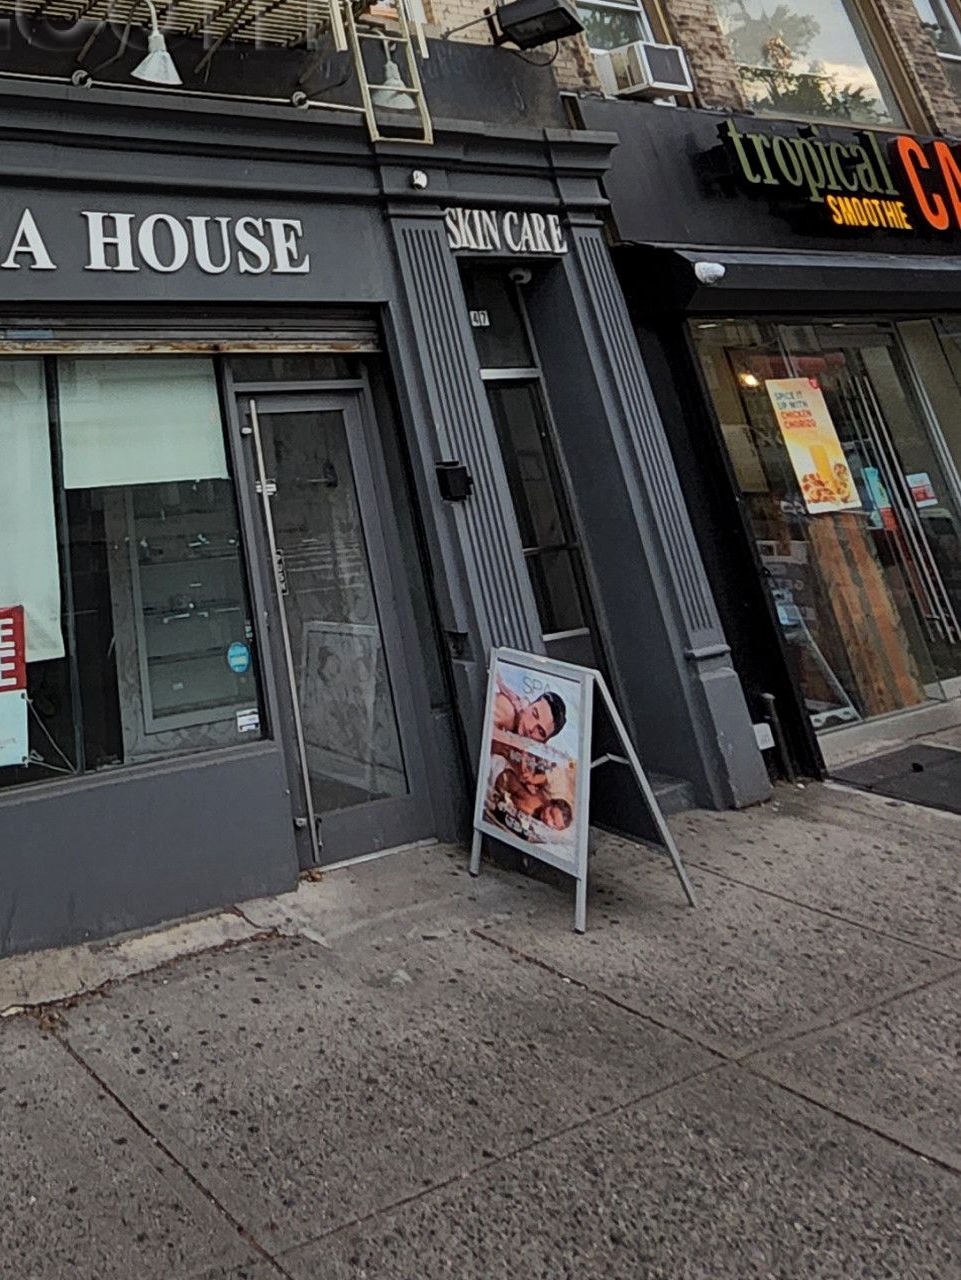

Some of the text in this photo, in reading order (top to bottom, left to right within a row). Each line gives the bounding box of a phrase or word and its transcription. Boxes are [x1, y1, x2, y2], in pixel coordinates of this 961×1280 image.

[726, 118, 900, 203] tropical
[445, 207, 568, 253] SKIN CARE
[826, 194, 914, 230] SMOOTHIE
[80, 210, 311, 275] HOUSE
